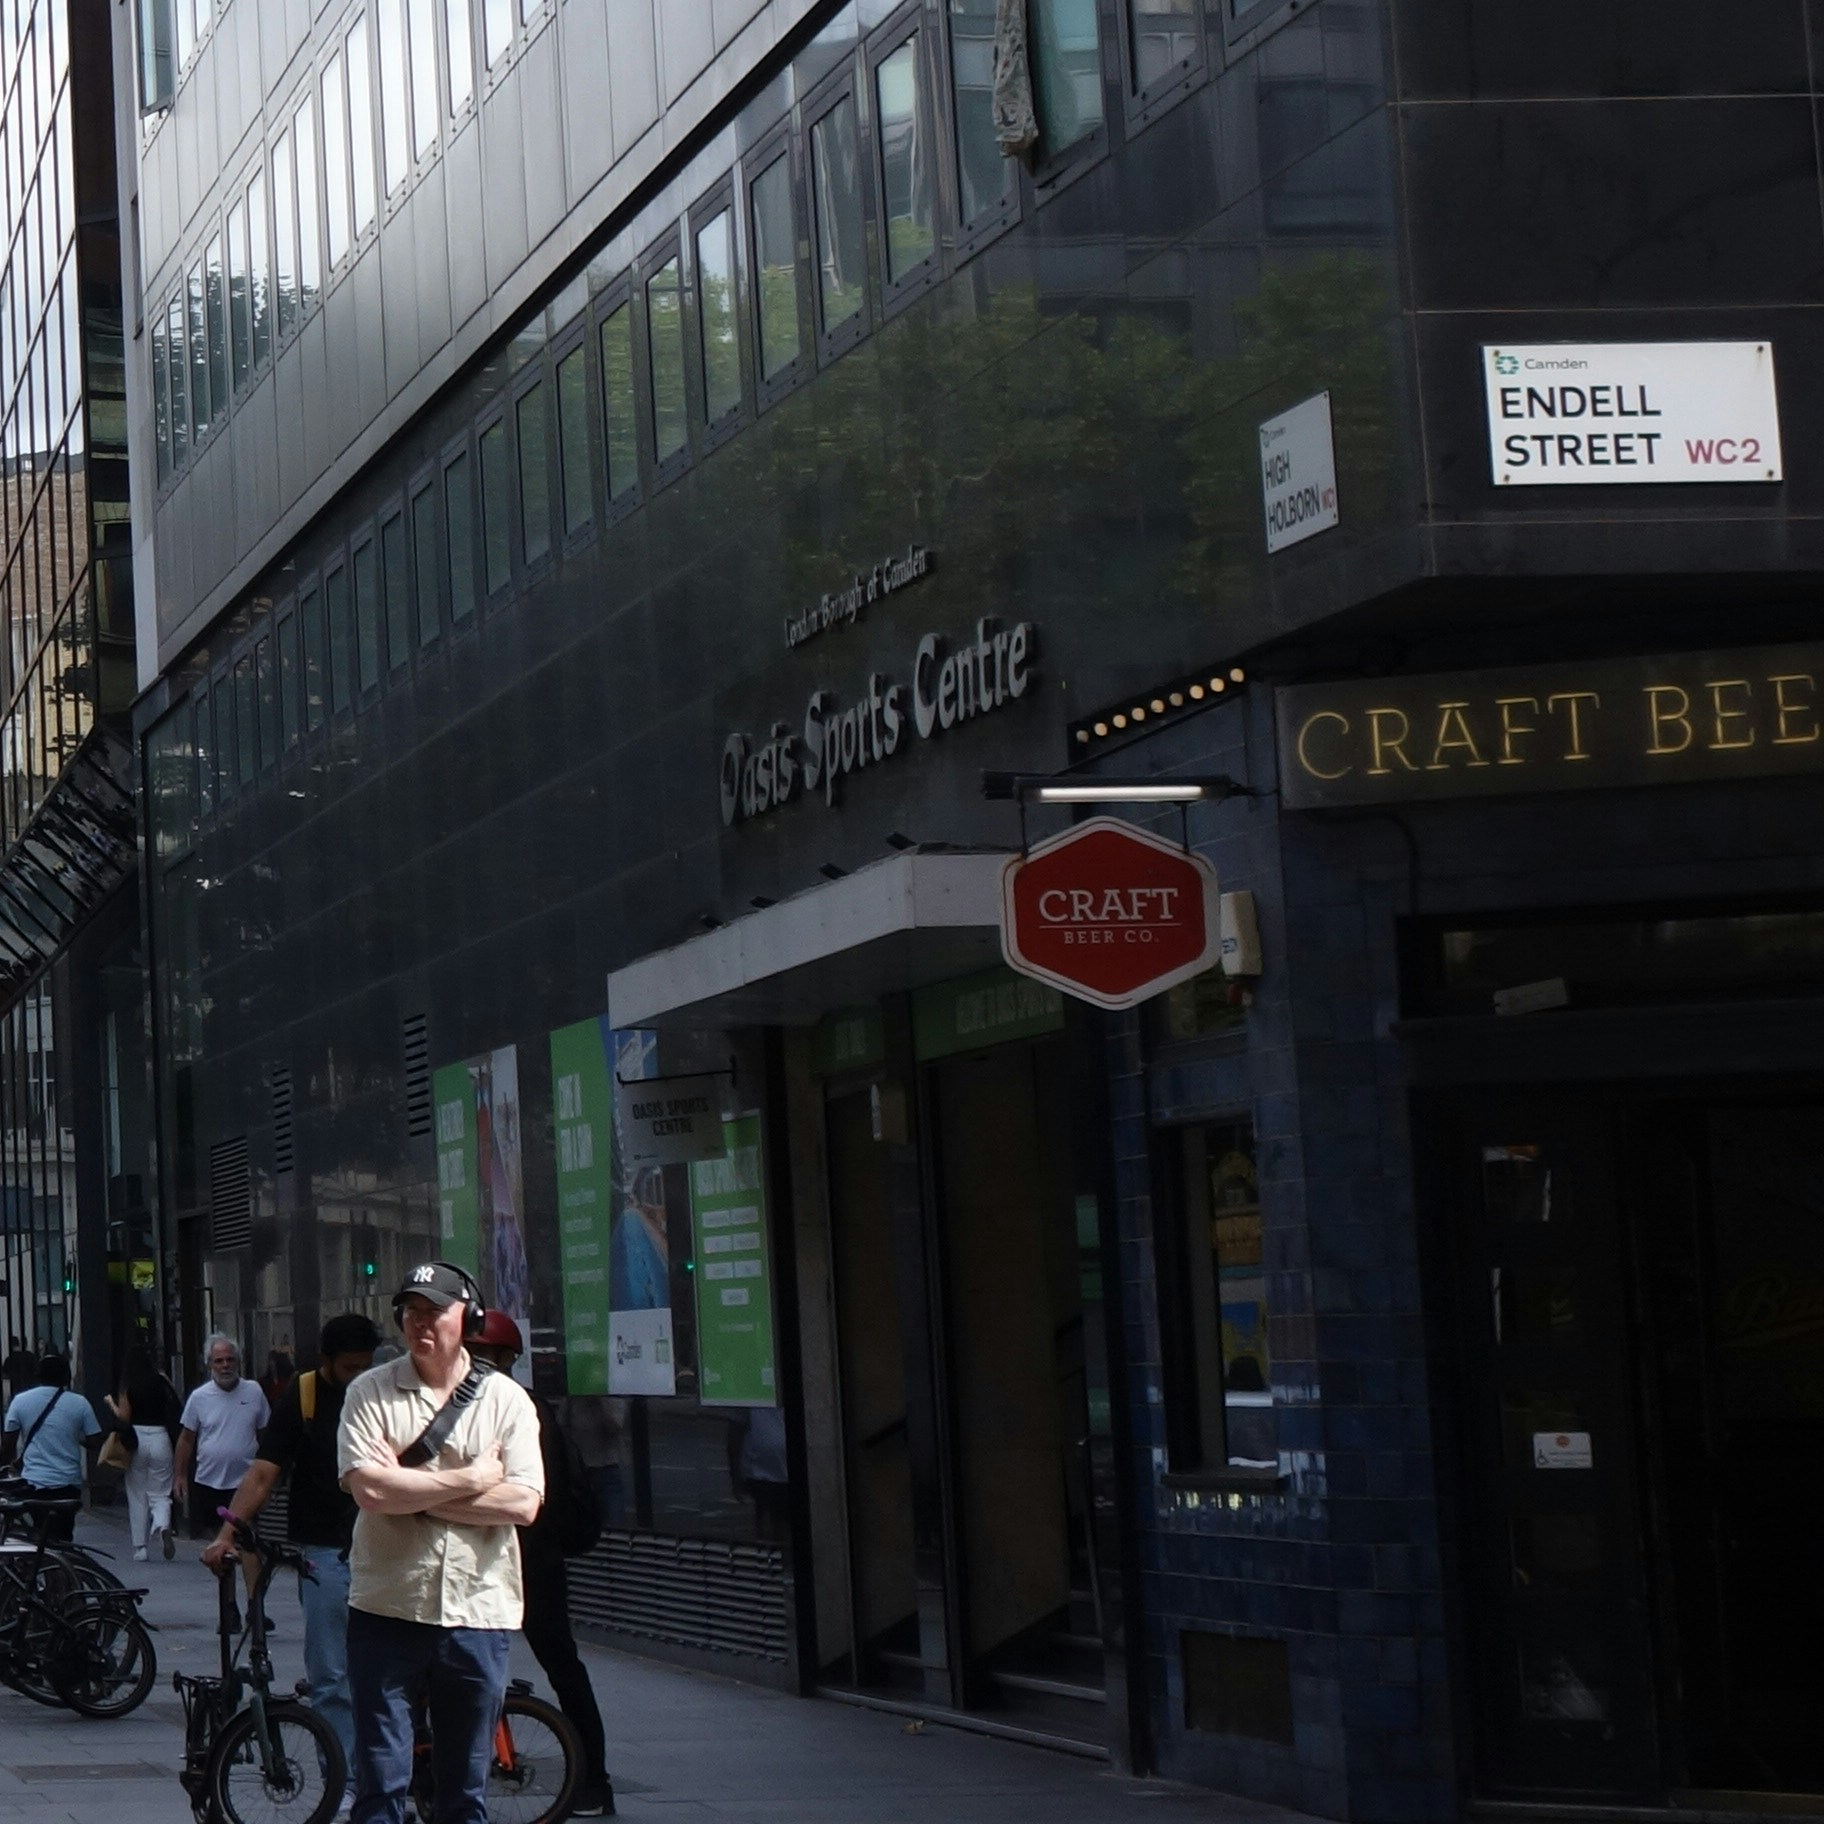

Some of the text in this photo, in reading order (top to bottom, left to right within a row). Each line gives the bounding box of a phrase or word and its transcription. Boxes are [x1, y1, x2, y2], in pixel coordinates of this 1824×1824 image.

[1524, 357, 1589, 371] Camden
[1499, 385, 1661, 418] ENDELL
[1504, 433, 1761, 467] STREET WC2
[1265, 450, 1291, 490] HIGH
[1267, 484, 1321, 535] HOLBORN
[867, 565, 879, 603] of
[883, 544, 926, 594] Camden
[720, 616, 1032, 827] Oasis Sports Centre
[1297, 693, 1600, 779] CRAFT
[1039, 888, 1179, 922] CRAFT
[1064, 930, 1160, 944] BEER CO.
[632, 1097, 709, 1120] OASIS SPORTS
[653, 1118, 694, 1136] CENTRE
